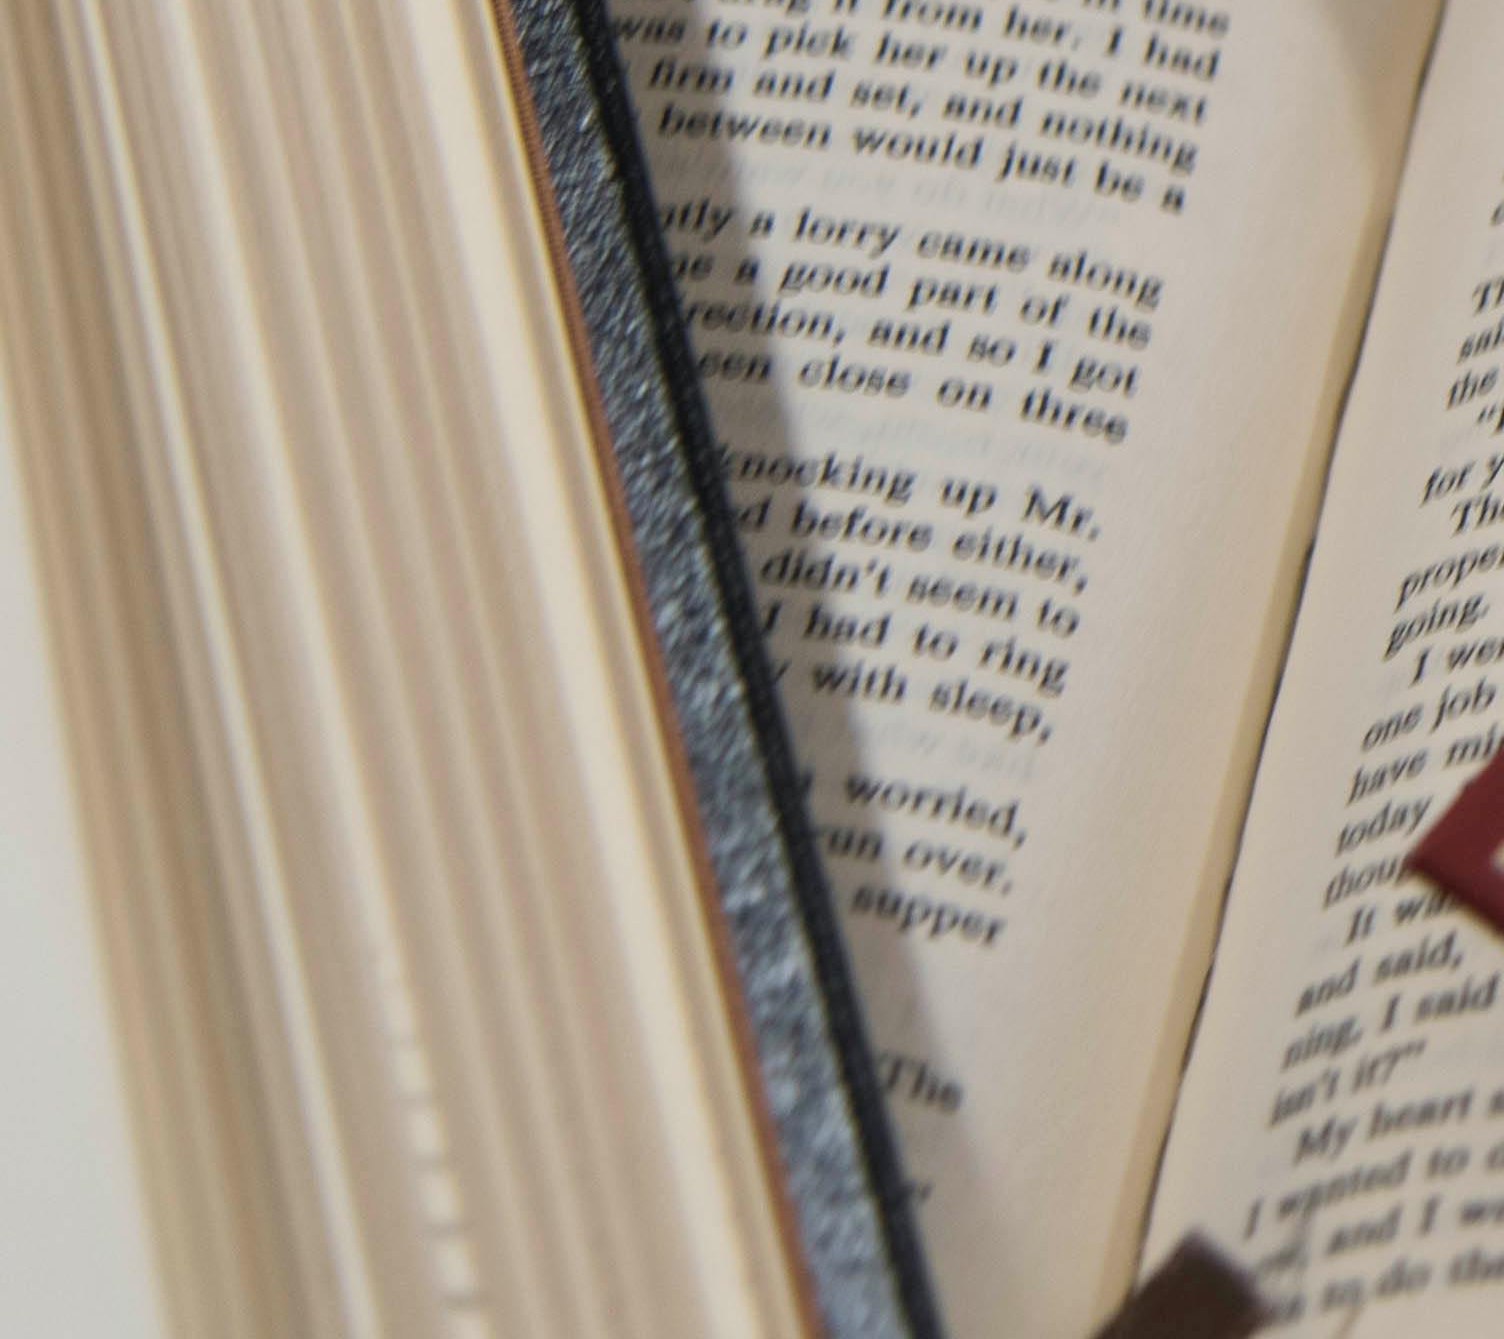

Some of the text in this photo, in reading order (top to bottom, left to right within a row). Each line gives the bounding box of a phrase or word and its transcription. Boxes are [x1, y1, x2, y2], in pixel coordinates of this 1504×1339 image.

[655, 98, 1146, 202] between would just be
[746, 205, 1165, 312] a lorry came along
[731, 257, 1152, 349] a good part of the
[866, 318, 1140, 399] and so I got
[1445, 365, 1499, 412] the
[796, 352, 1130, 446] close on three
[786, 498, 935, 552] before
[939, 478, 1000, 520] up
[904, 574, 1020, 622] seem
[1035, 596, 1082, 639] to
[800, 600, 1071, 698] had to ring
[1408, 645, 1433, 689] I
[808, 661, 909, 704] with
[1360, 676, 1498, 754] one job
[1345, 748, 1430, 808] have
[841, 772, 1029, 852] worried,
[1333, 795, 1434, 859] today
[849, 884, 1006, 948] supper
[1293, 956, 1363, 1019] and
